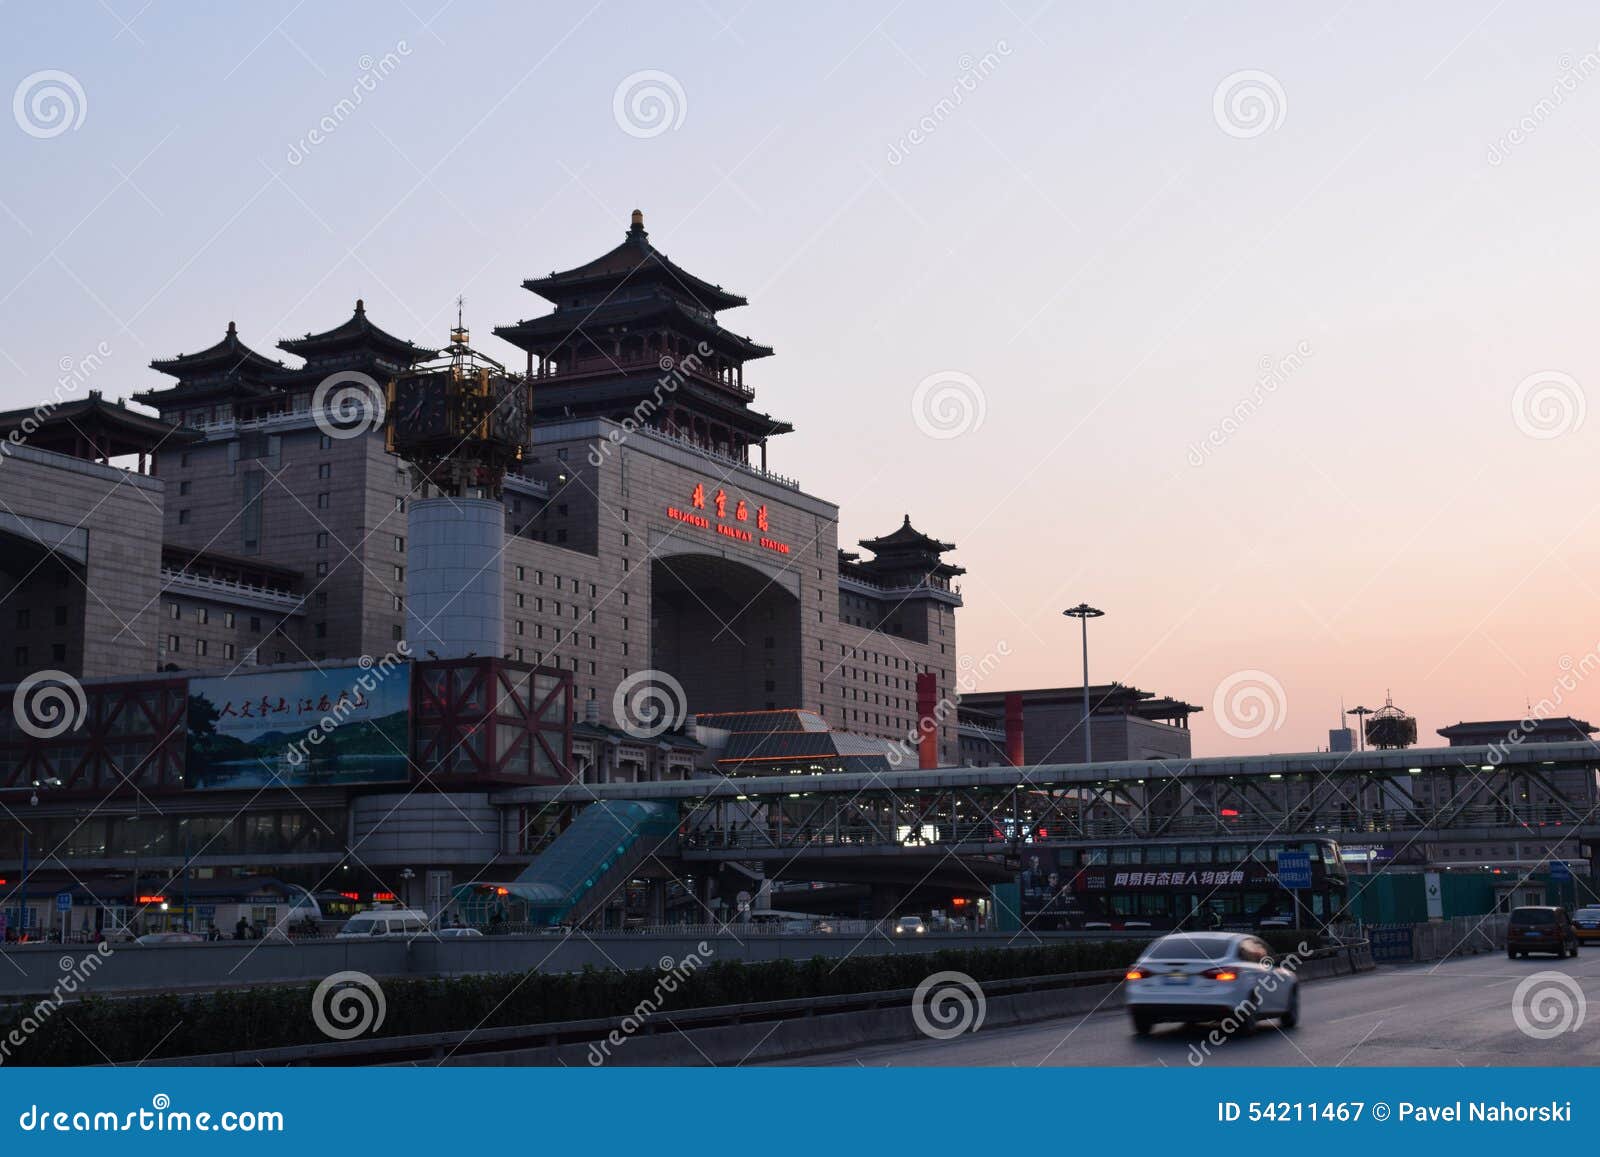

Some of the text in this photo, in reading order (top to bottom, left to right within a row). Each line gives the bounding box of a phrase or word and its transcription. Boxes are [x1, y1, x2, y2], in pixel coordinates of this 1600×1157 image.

[667, 507, 789, 554] BEIJINGXI RAILWAY STATION
[692, 483, 769, 532] 北京西站
